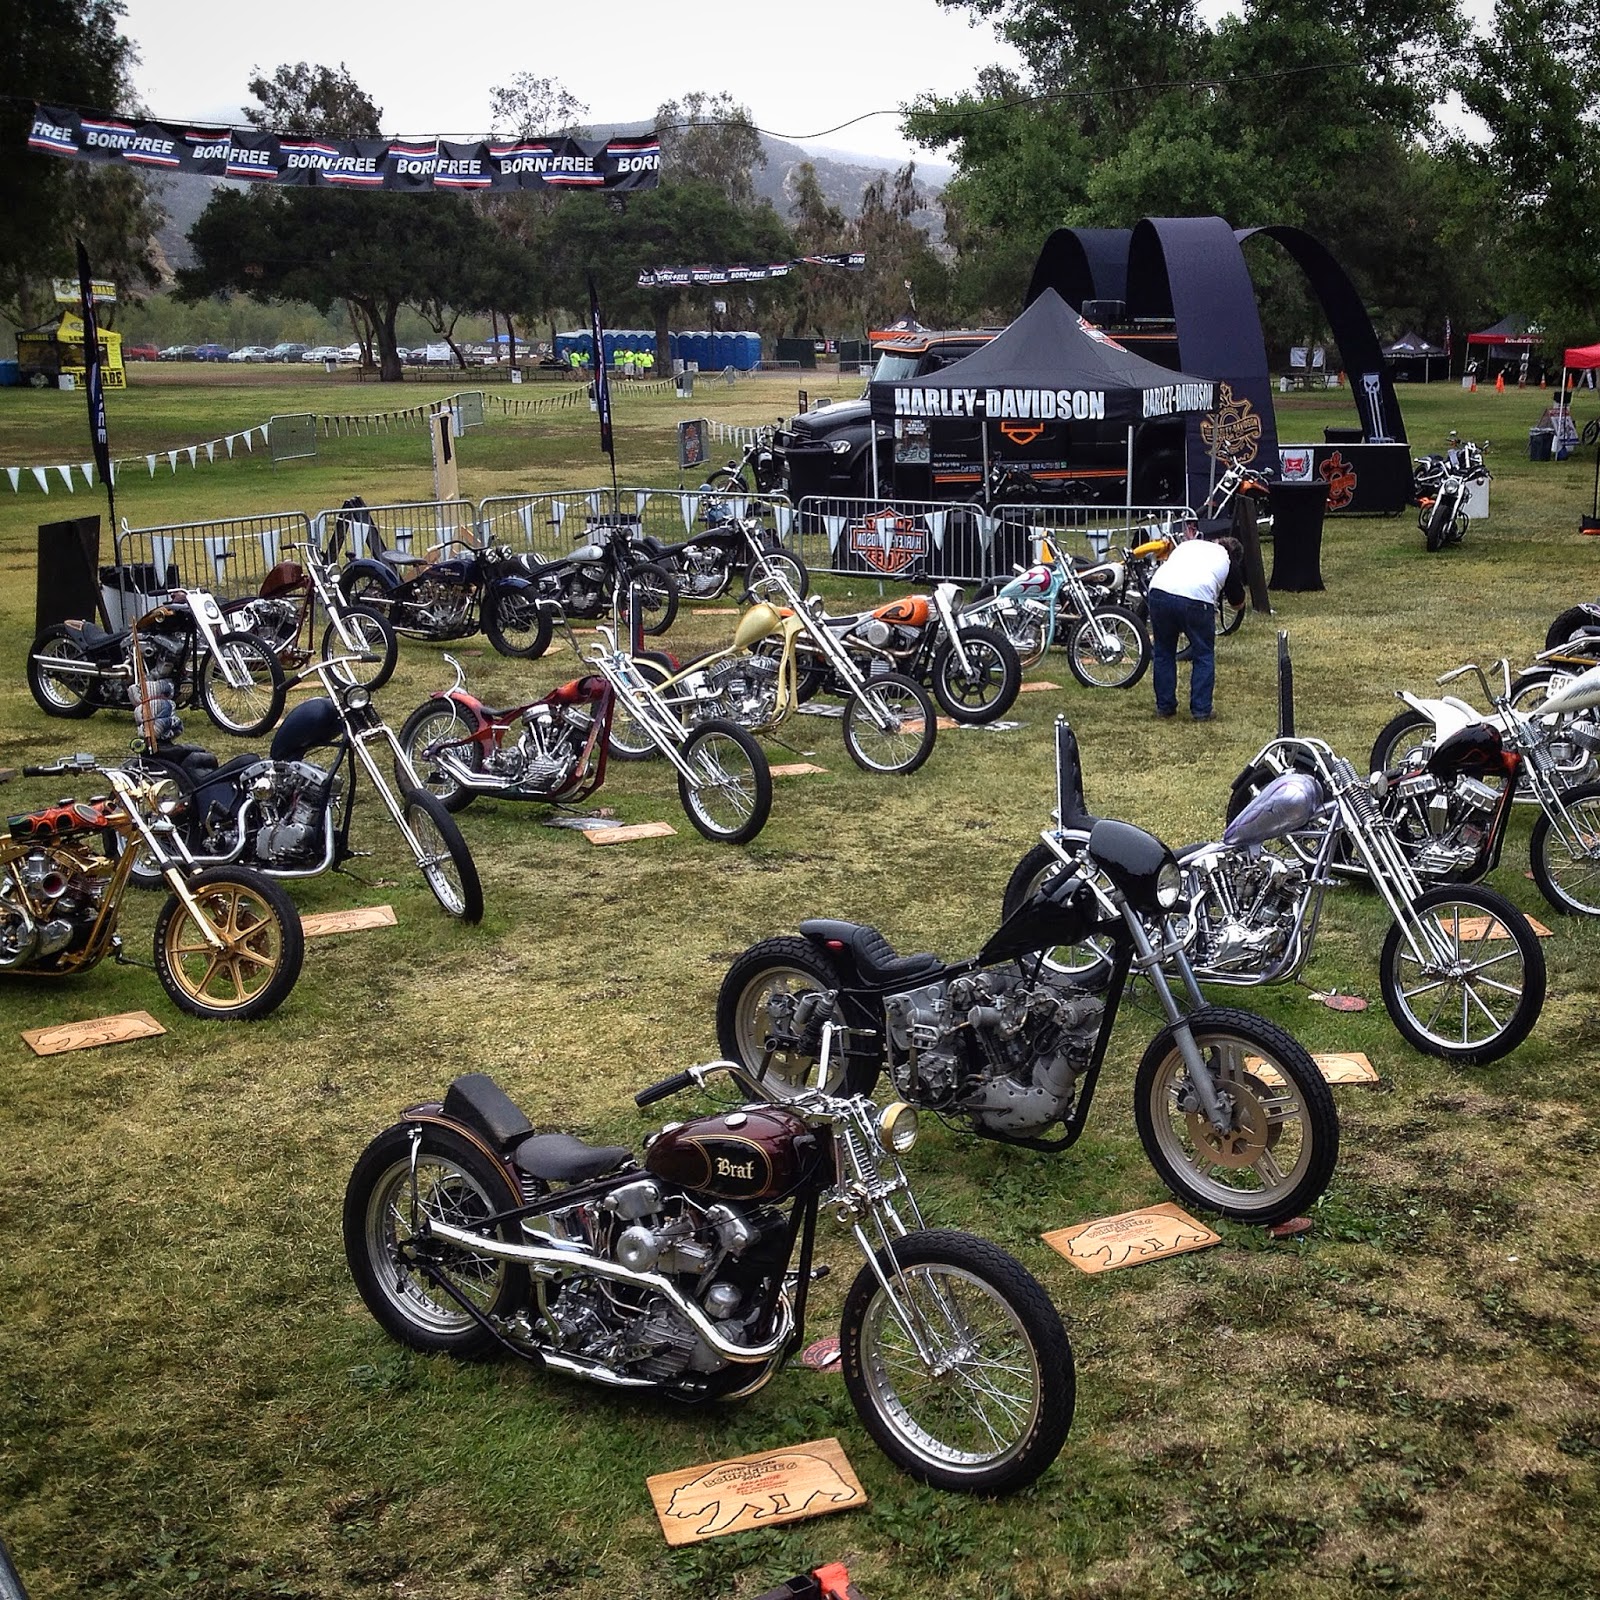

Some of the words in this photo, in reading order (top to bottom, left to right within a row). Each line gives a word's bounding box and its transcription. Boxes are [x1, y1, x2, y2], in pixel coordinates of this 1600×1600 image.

[31, 121, 72, 142] FREE
[86, 131, 175, 155] BORN-FREE
[229, 148, 271, 165] FREE
[287, 153, 376, 173] BORN-FREE
[437, 159, 482, 175] FREE
[500, 155, 594, 175] BORN-FREE
[894, 388, 1105, 420] HARLEY-DAVIDSON
[1142, 383, 1213, 418] HARLEY-DAVIDSON
[715, 1157, 754, 1180] Brat
